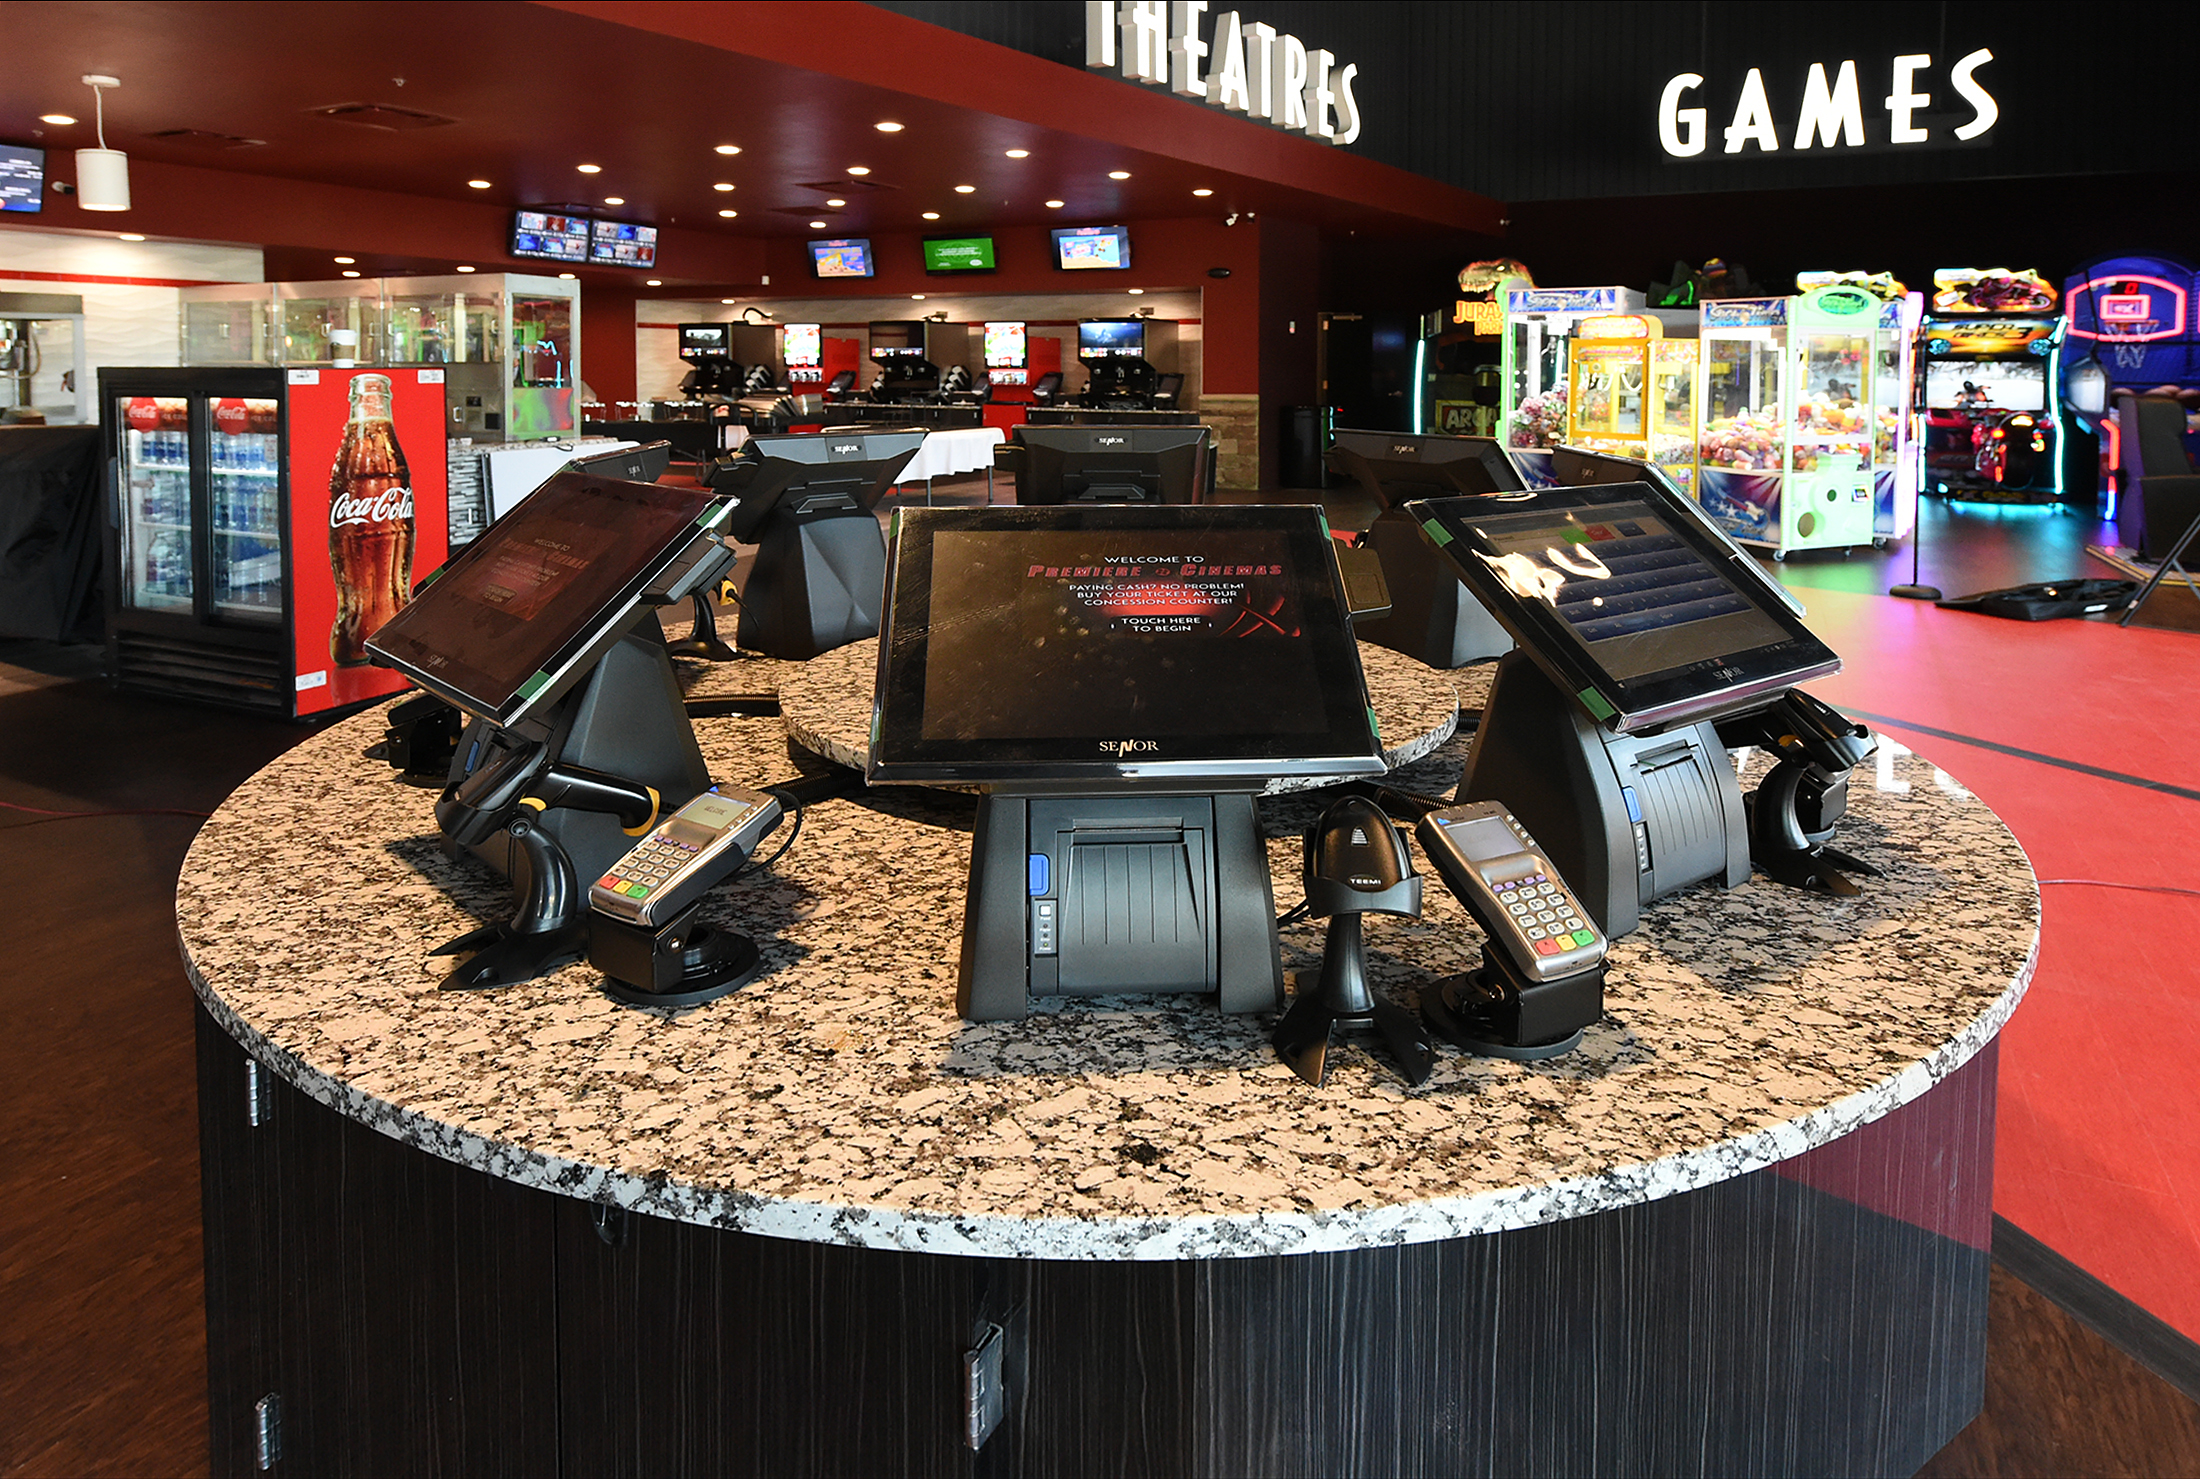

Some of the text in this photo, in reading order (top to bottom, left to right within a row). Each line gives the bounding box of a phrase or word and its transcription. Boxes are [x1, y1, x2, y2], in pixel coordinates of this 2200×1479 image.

[1658, 47, 1999, 158] GAMES
[330, 487, 414, 529] Coca-Cola
[1104, 555, 1204, 564] WELCOME TO
[1027, 563, 1283, 578] PREMIERE CINEMAS
[1117, 583, 1157, 591] CASH?
[1184, 582, 1245, 590] PROBLEM!
[1077, 590, 1237, 599] BUY YOUR TICKET AT OUR
[1084, 597, 1233, 606] CONCESSION COUNTER!
[1121, 616, 1201, 625] TOUCH HERE
[1155, 624, 1192, 632] BEGIN
[1098, 738, 1160, 758] SENOR
